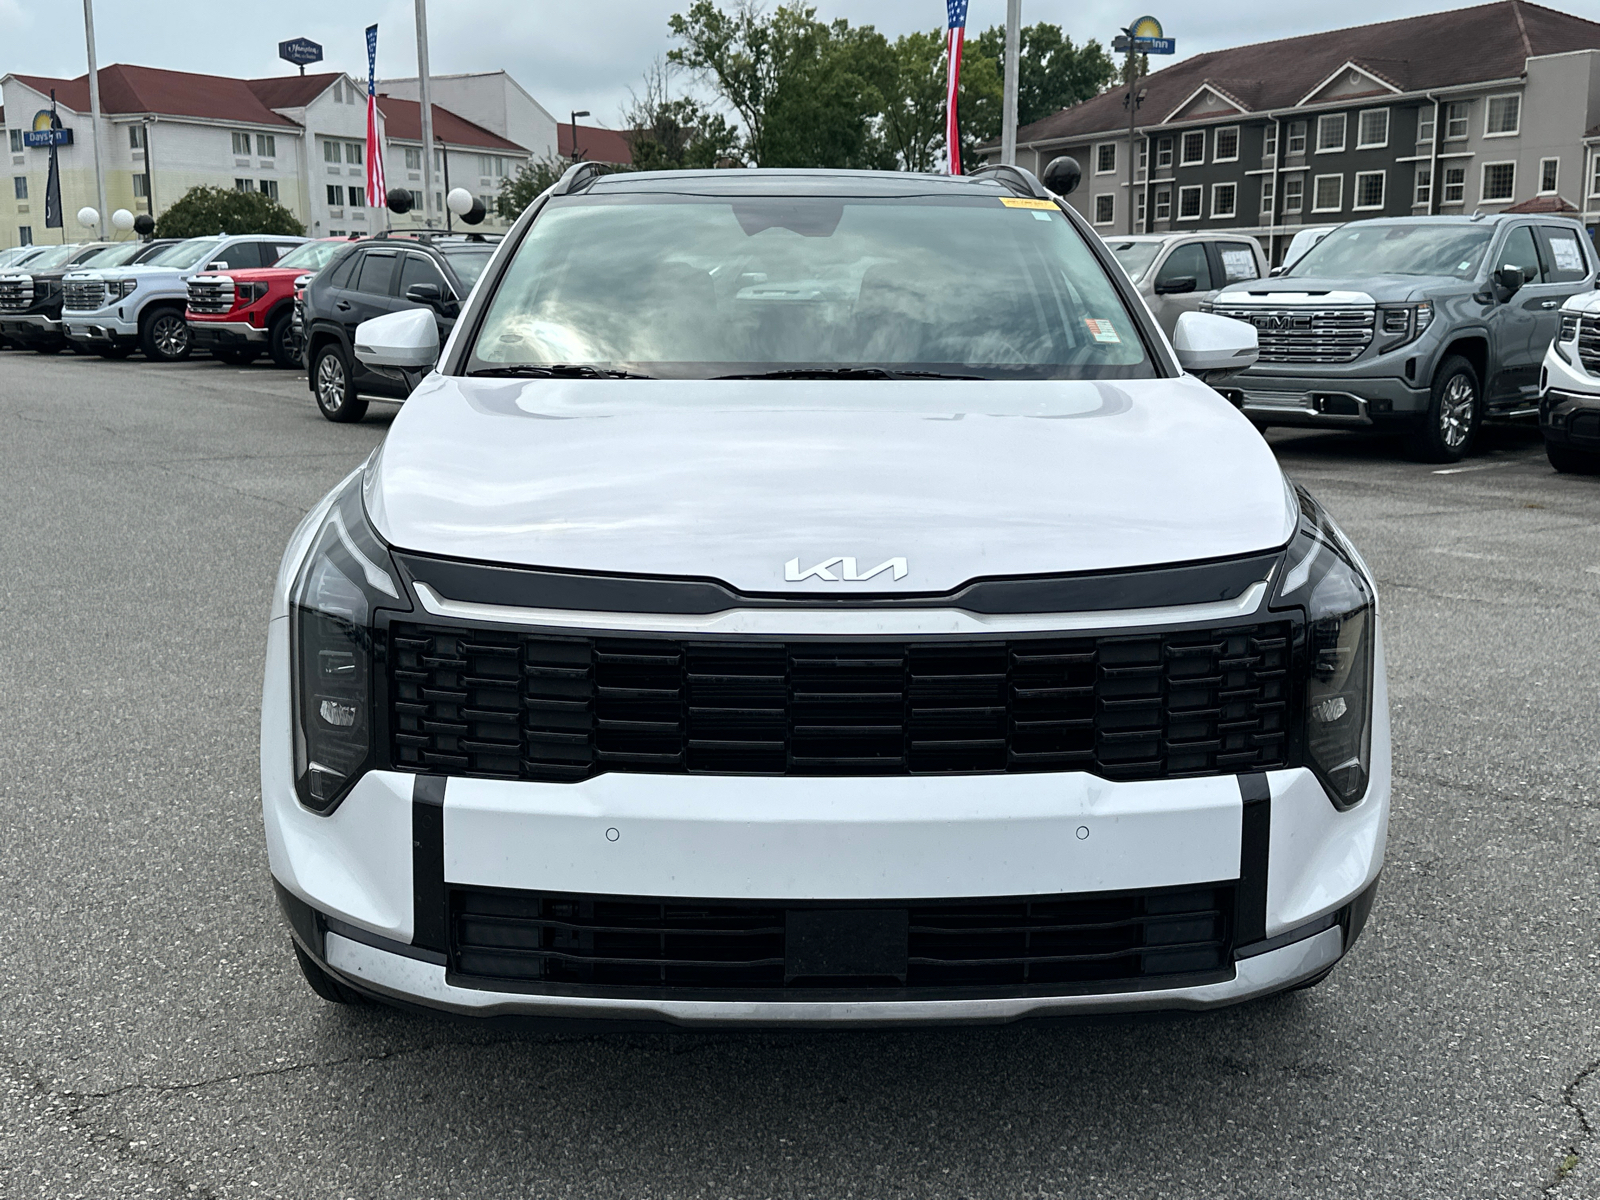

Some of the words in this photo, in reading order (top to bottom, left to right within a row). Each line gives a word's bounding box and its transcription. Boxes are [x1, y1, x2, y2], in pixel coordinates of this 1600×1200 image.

[29, 132, 49, 142] Days
[1252, 316, 1311, 330] GMC
[784, 556, 909, 582] KIA
